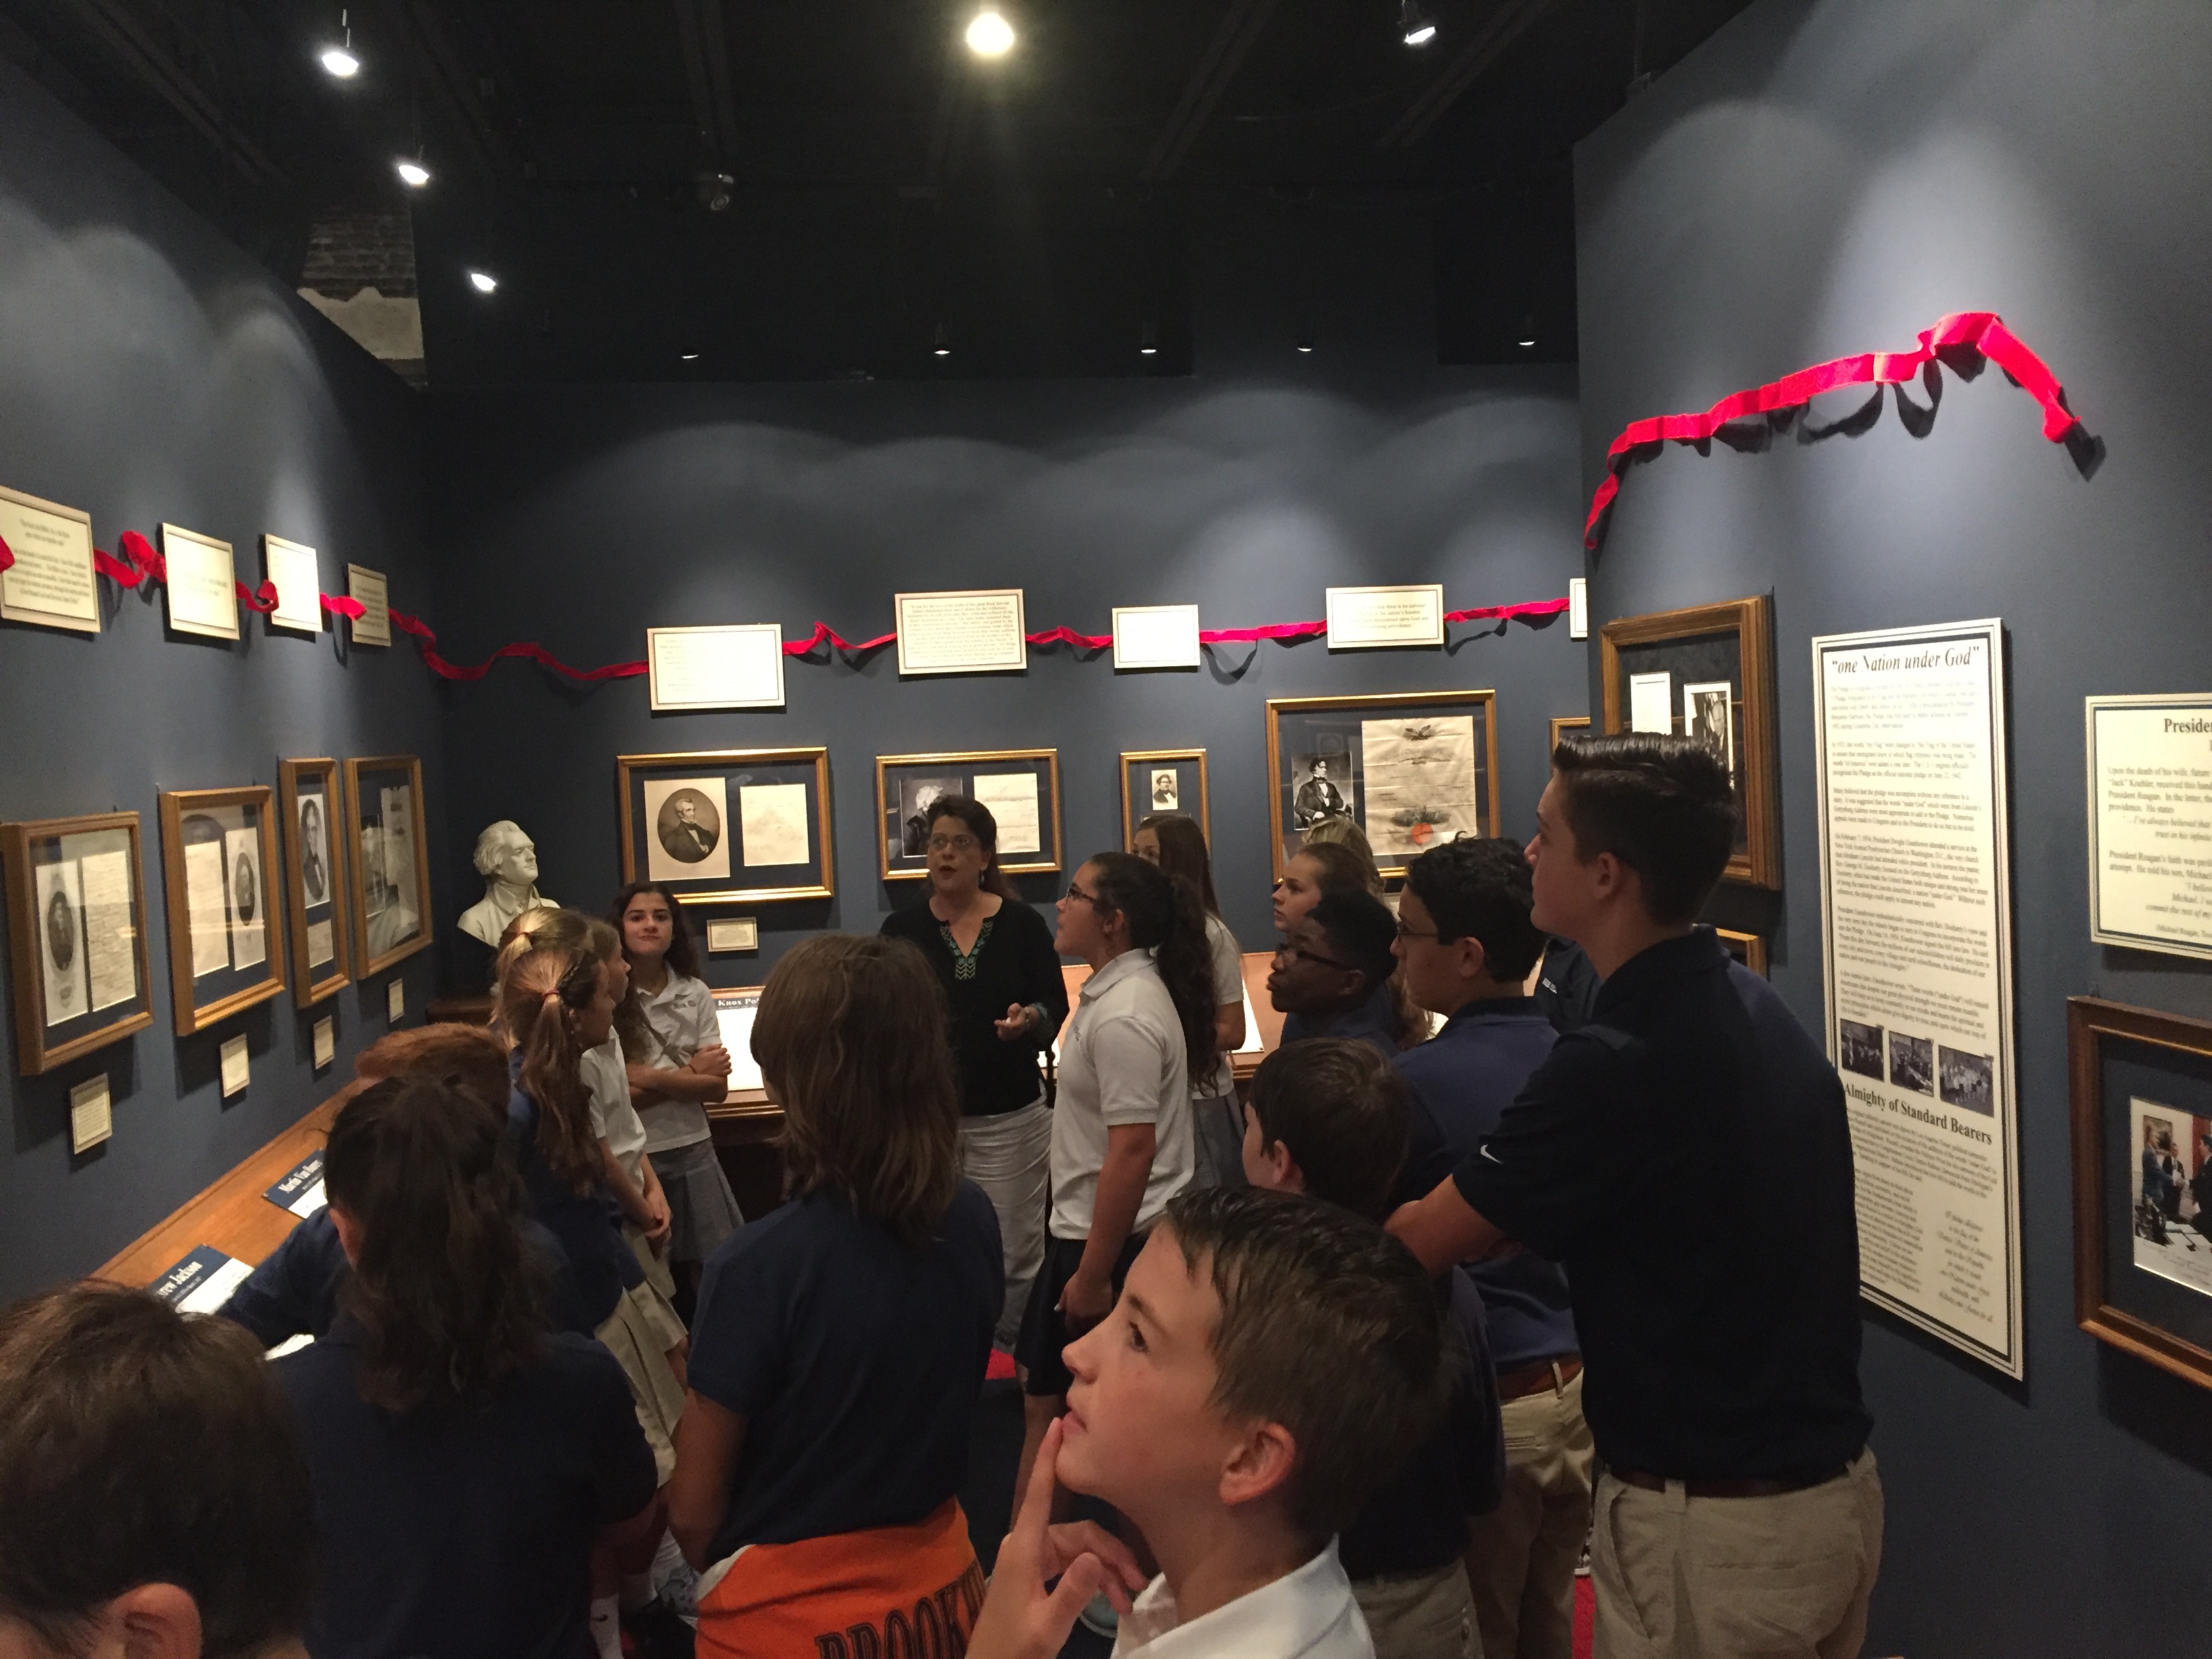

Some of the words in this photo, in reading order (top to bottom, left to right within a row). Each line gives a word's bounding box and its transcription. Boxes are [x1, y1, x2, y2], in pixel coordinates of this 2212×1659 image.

[1861, 654, 1900, 672] Nation
[1905, 650, 1941, 670] under
[1946, 646, 1980, 667] God”
[1845, 1082, 1886, 1111] Almighty
[1889, 1098, 1899, 1113] of
[1901, 1101, 1948, 1132] Standard
[1950, 1115, 1992, 1145] Bearers
[157, 1281, 177, 1299] rew
[169, 1261, 203, 1285] Jackson
